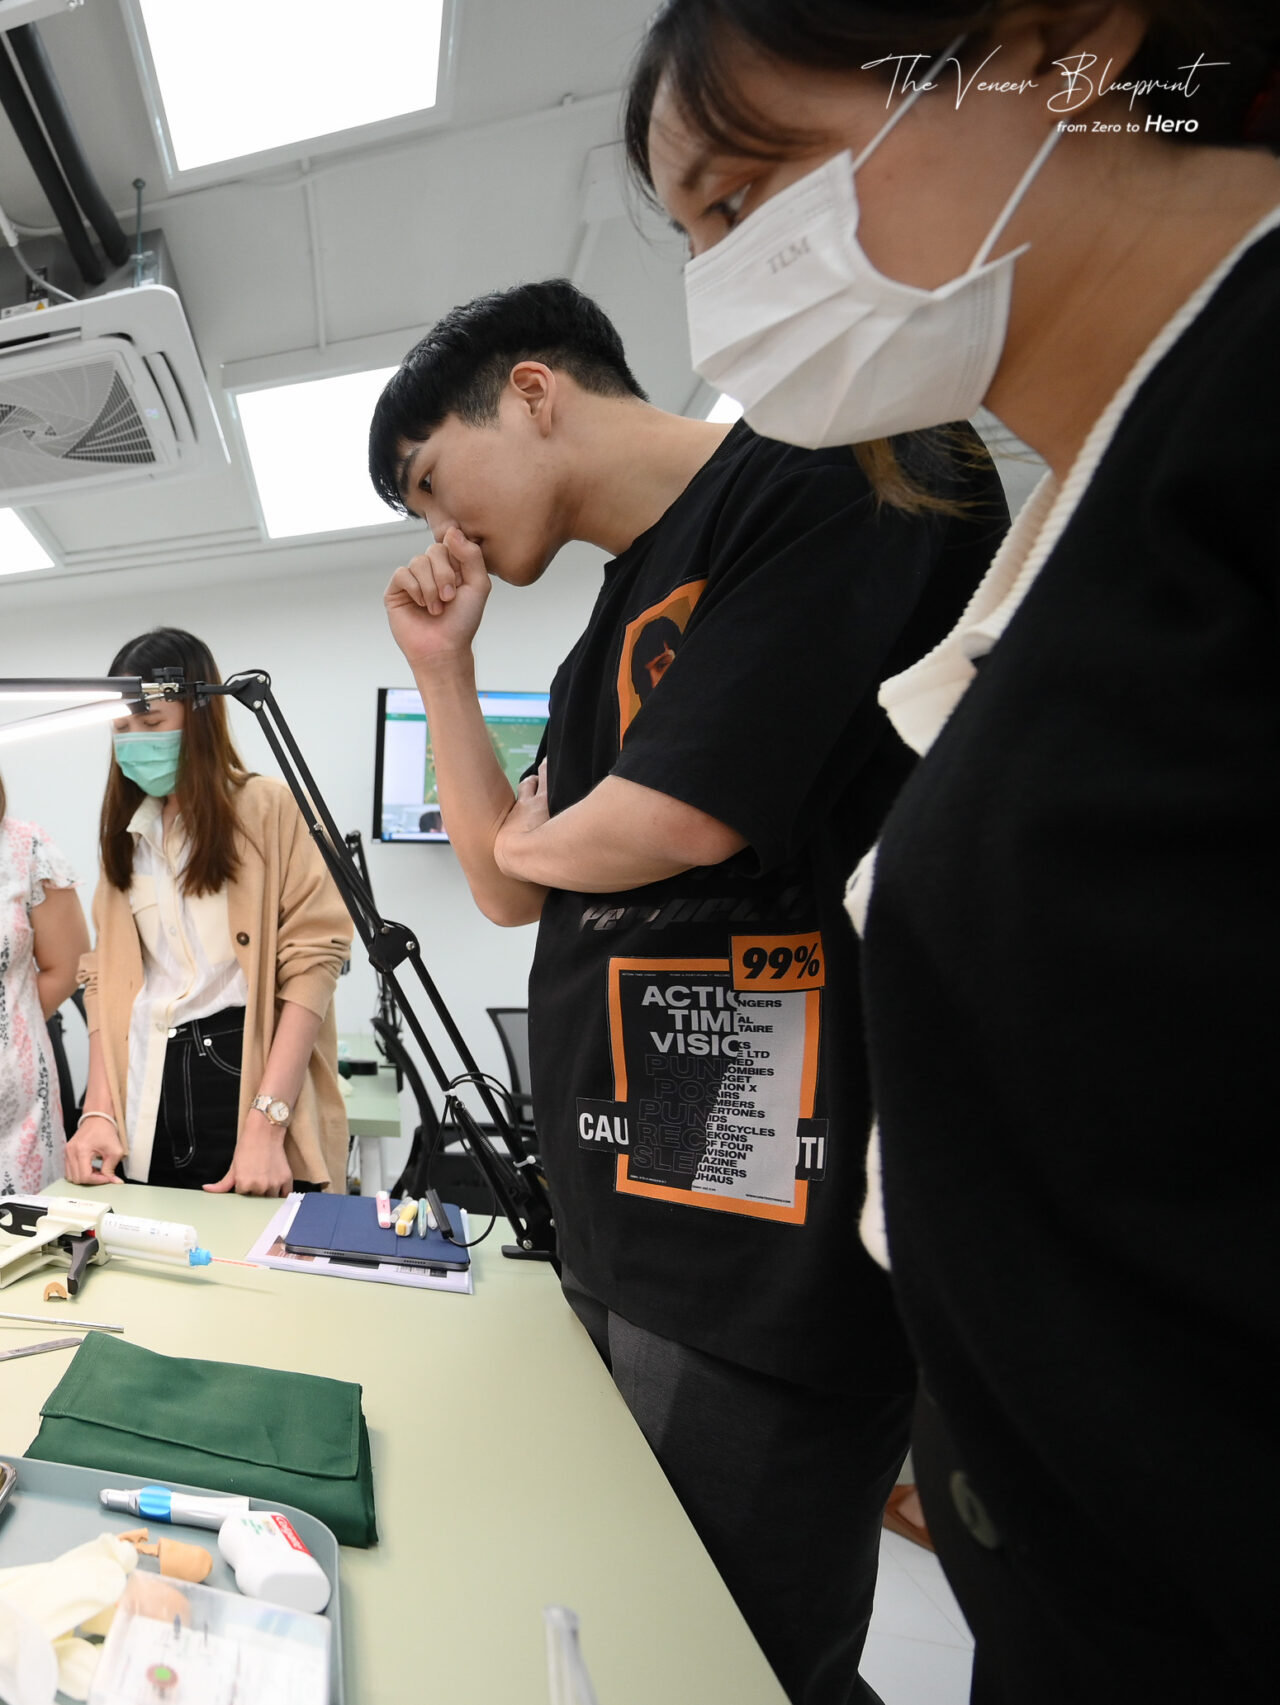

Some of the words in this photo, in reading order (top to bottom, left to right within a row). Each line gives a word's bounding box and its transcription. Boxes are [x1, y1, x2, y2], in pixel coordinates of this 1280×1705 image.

[742, 943, 821, 979] 99%
[747, 1050, 770, 1059] LTD
[749, 1084, 757, 1092] X
[578, 1112, 629, 1146] CAU
[716, 1123, 775, 1137] BICYCLES
[720, 1141, 753, 1152] FOUR
